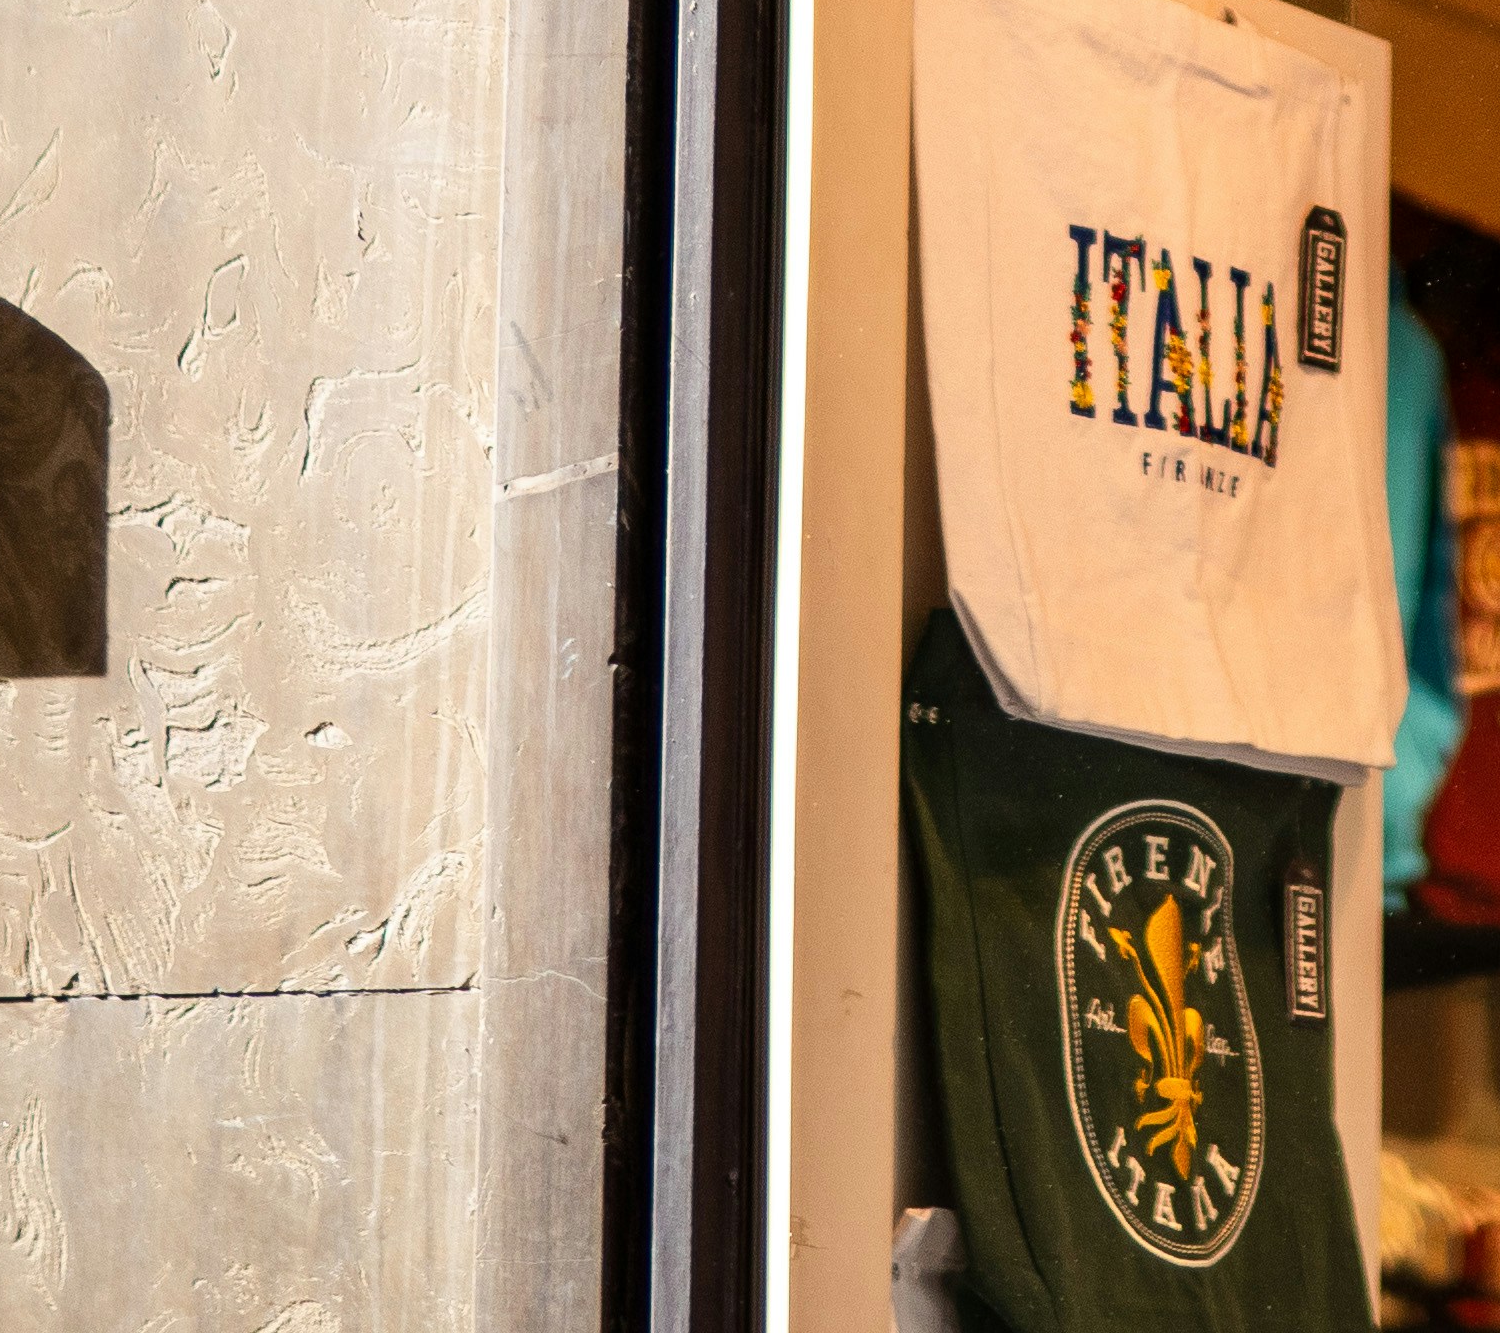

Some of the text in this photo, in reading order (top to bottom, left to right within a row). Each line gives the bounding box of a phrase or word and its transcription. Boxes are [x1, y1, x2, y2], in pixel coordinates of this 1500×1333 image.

[1068, 222, 1284, 469] ITALIA
[1311, 240, 1337, 354] GALLERY
[1296, 895, 1320, 1010] GALLERY
